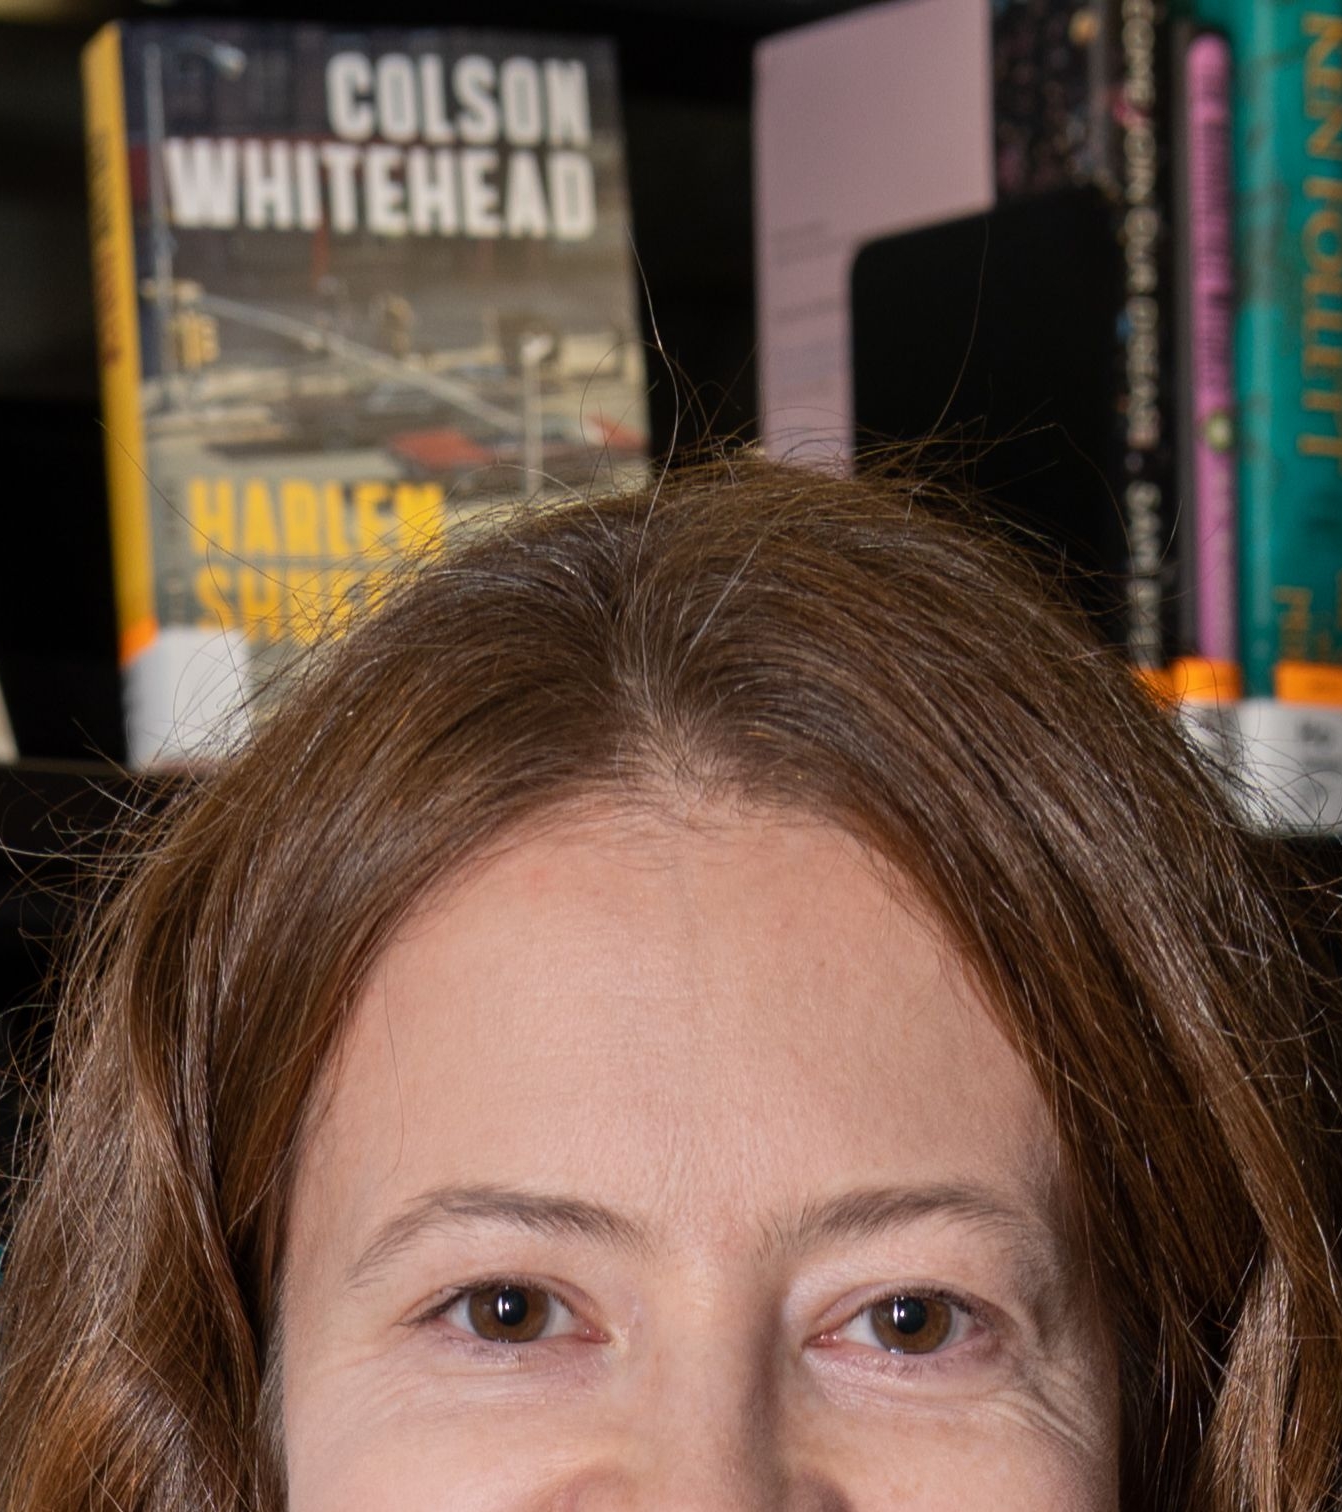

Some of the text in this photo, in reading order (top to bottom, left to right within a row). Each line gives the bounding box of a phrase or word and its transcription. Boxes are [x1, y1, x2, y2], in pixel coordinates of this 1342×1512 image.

[326, 50, 592, 144] COLSON
[164, 137, 597, 241] WHITEHEAD
[187, 476, 447, 562] HARLEM
